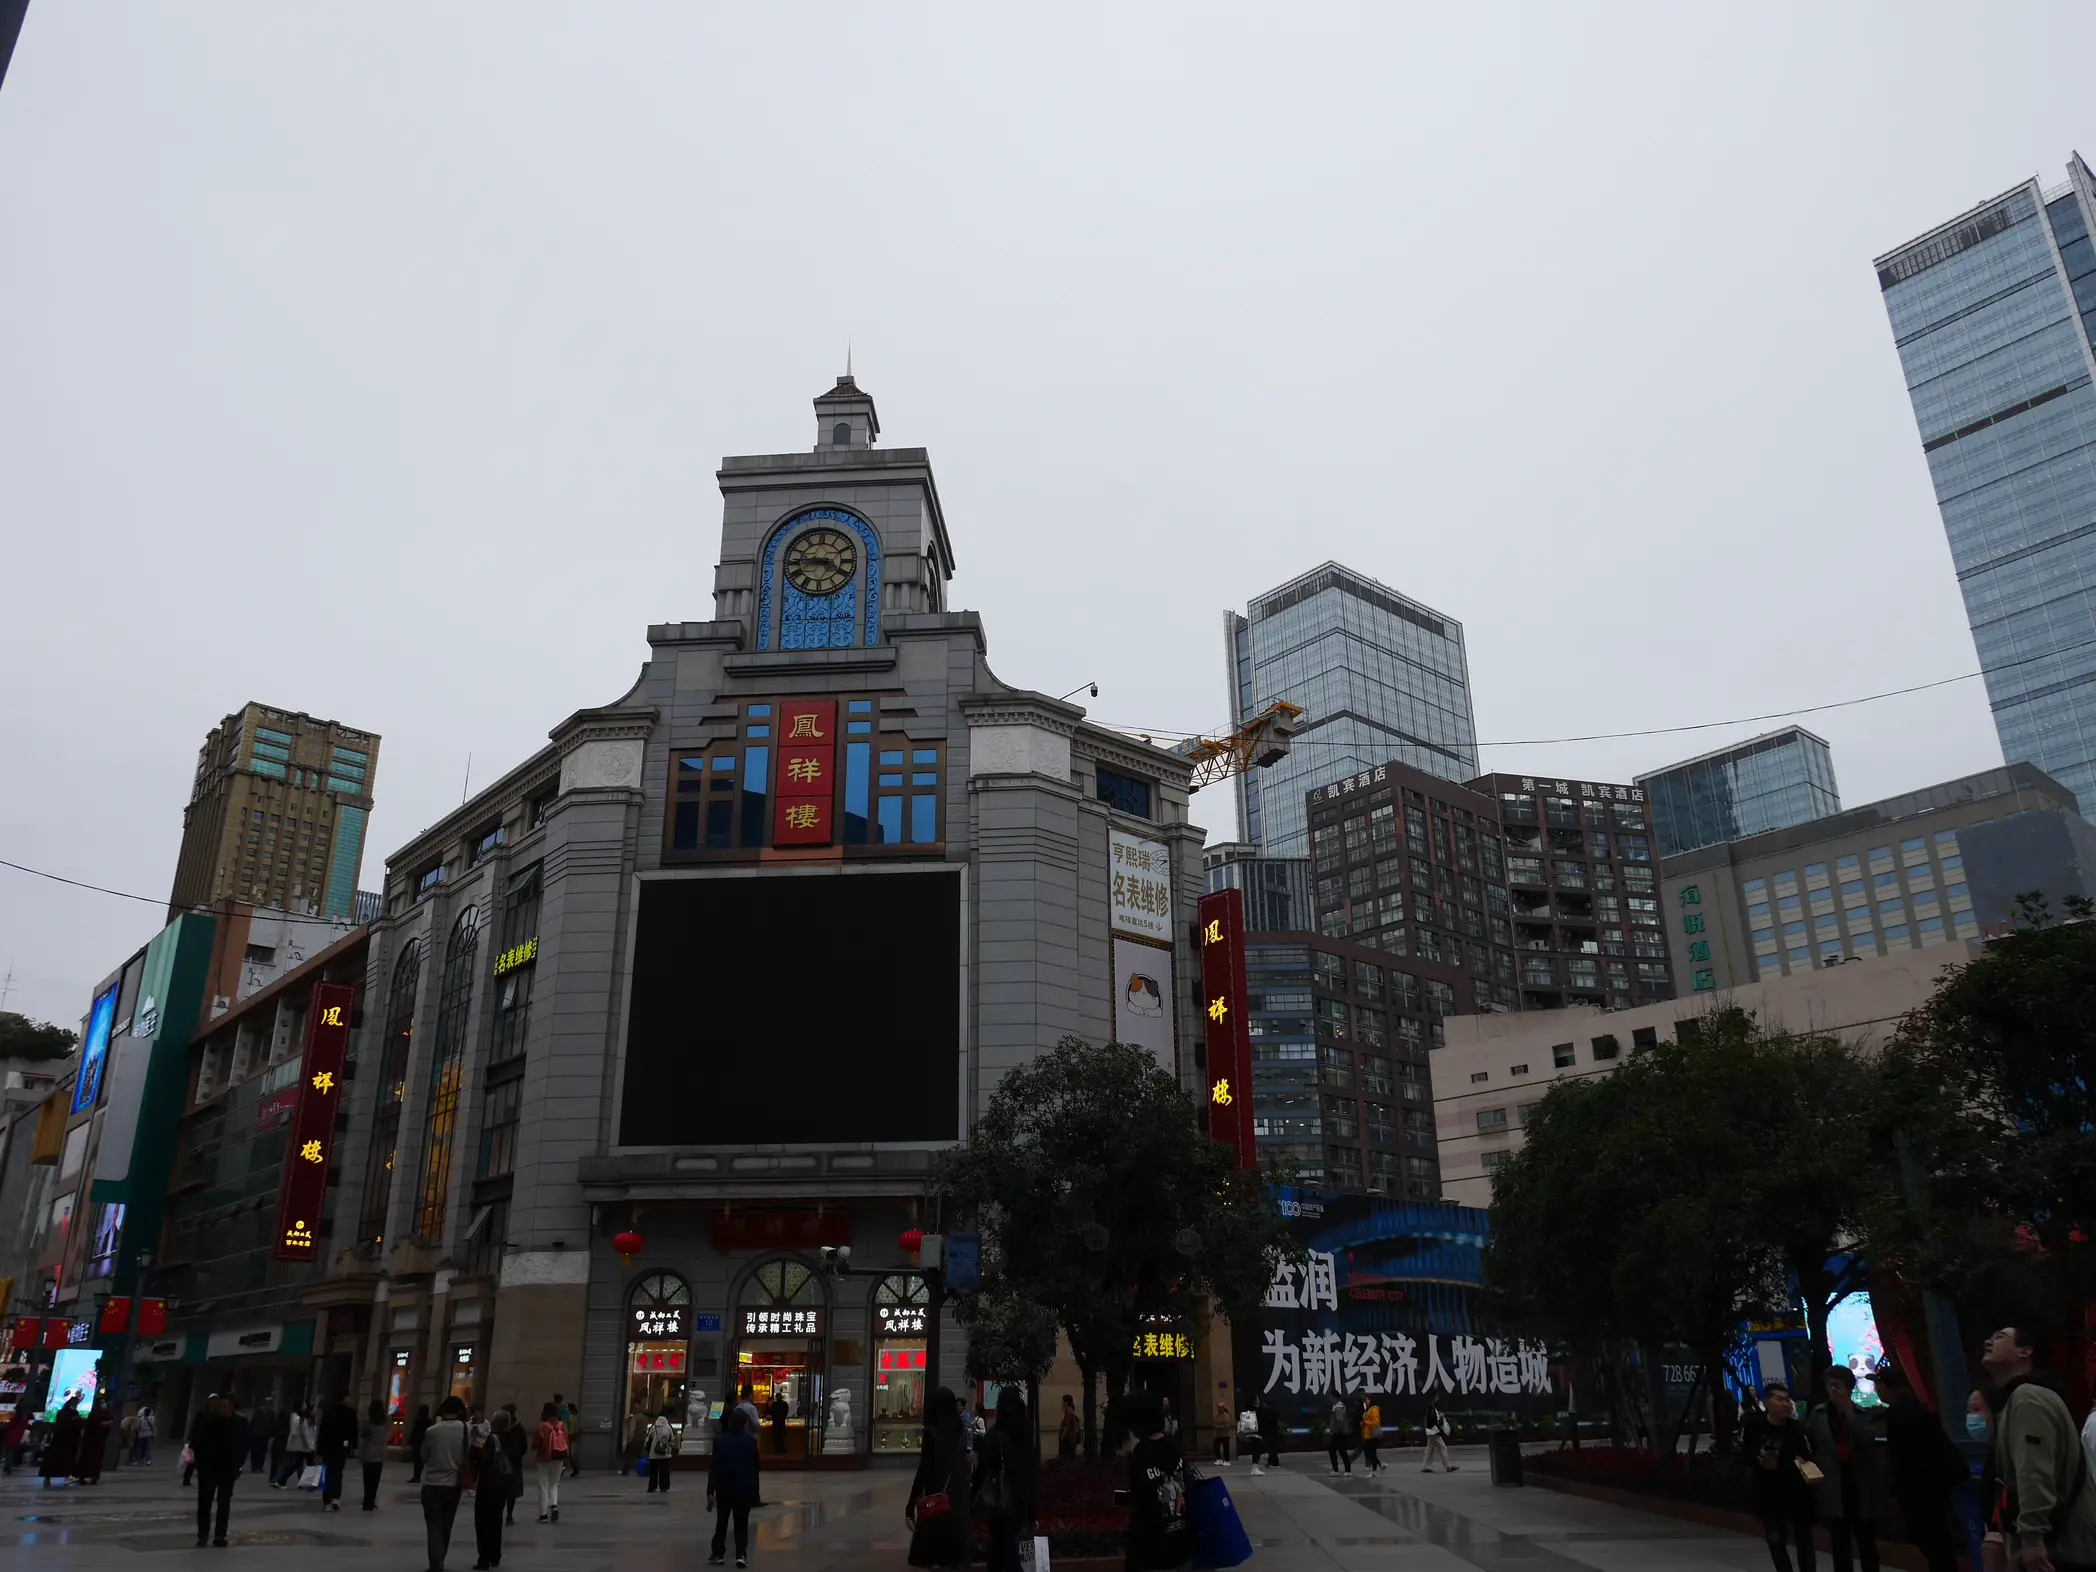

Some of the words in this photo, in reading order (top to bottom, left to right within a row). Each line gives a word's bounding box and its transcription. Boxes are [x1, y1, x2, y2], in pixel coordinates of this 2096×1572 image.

[786, 714, 824, 829] 鳳祥樓
[1327, 766, 1387, 799] 凯宾酒店
[1521, 777, 1569, 796] 第一城
[1580, 783, 1644, 802] 凯宾酒店
[1112, 841, 1151, 872] 亨熙瑞
[1112, 869, 1169, 917] 名表维修
[1679, 884, 1716, 992] 海悦酒店
[498, 940, 532, 974] 名表维修
[1388, 1289, 1404, 1302] CITY
[745, 1322, 816, 1334] 传承精工礼品
[746, 1311, 816, 1323] 引领时尚珠宝
[1262, 1328, 1552, 1395] 为新经济人物造城
